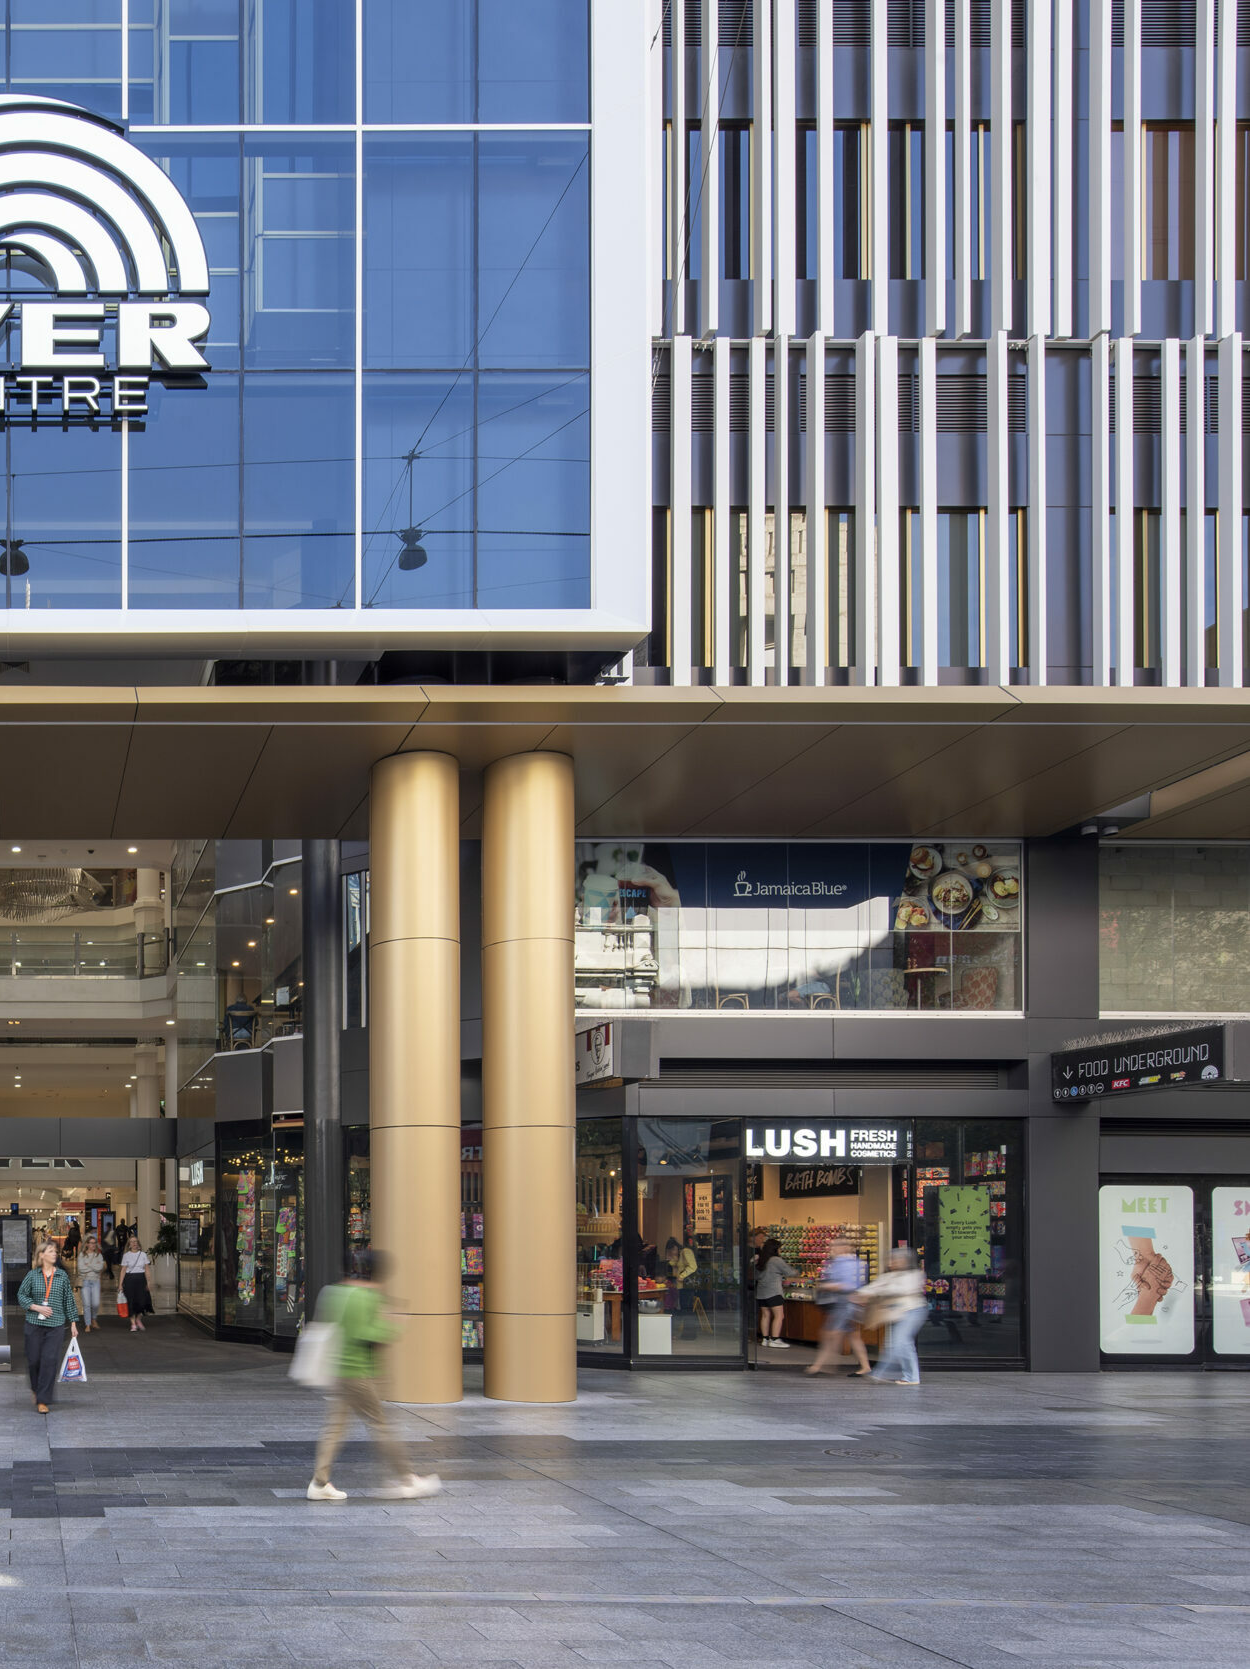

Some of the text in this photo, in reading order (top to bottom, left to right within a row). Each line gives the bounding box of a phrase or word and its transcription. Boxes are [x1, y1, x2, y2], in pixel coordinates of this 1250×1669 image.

[1078, 1043, 1209, 1079] FOOD UNDERGROUND
[1113, 1079, 1130, 1088] KFC
[745, 1128, 846, 1157] LUSH
[850, 1130, 898, 1142] FRESH
[850, 1142, 897, 1150] HANDMADE
[850, 1150, 897, 1158] COSMETICS
[784, 1169, 815, 1191] BATH
[816, 1166, 855, 1188] BOMBS
[1121, 1197, 1170, 1214] MEET
